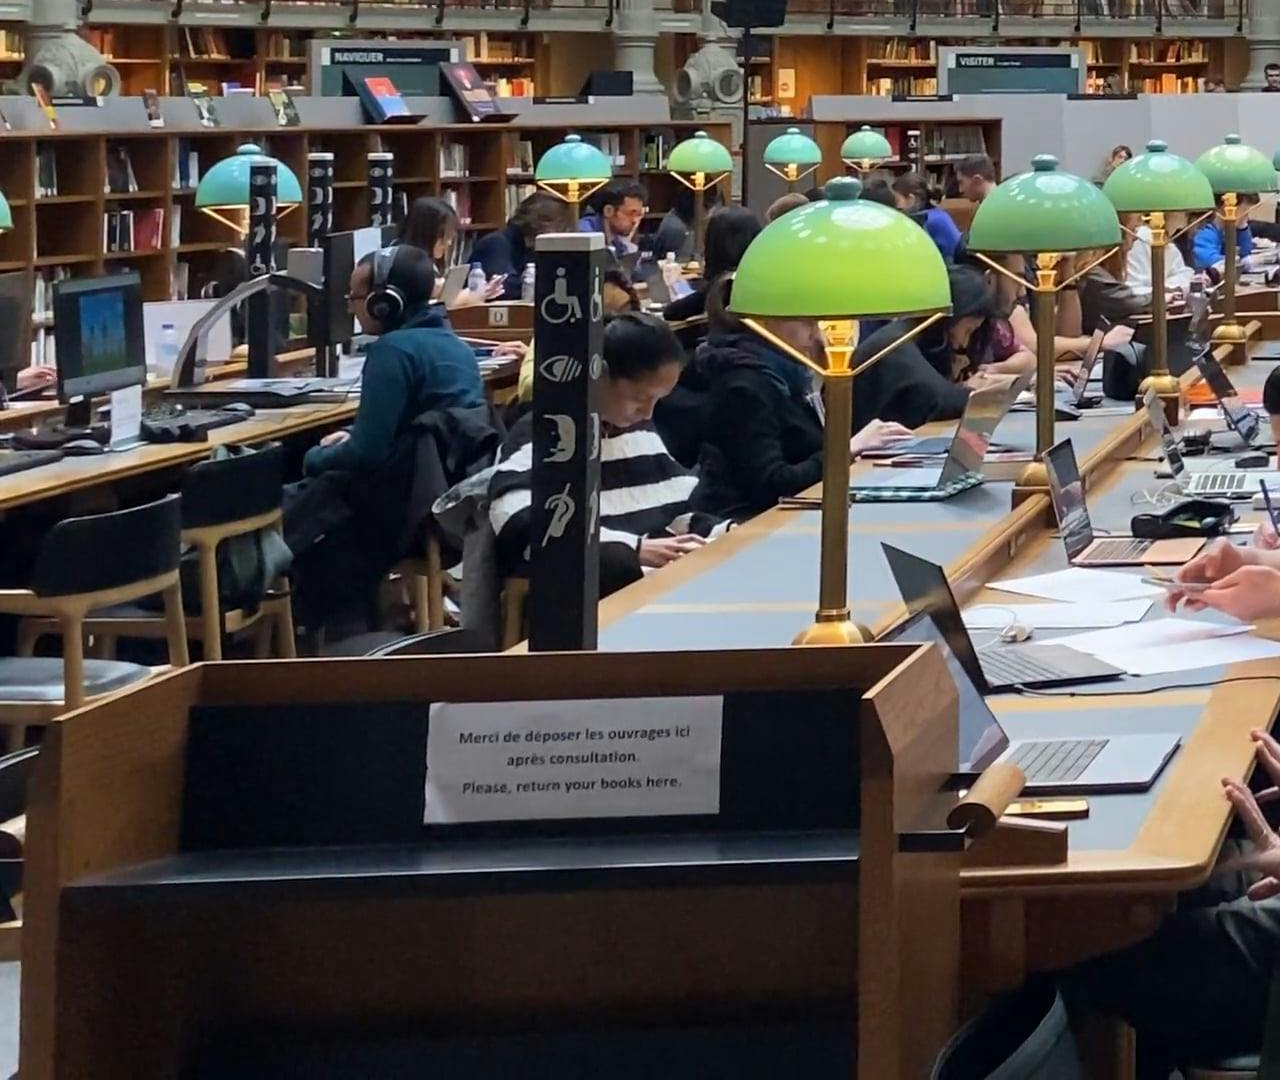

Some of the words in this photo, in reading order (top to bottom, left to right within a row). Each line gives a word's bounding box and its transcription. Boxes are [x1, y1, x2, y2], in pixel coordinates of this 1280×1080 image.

[334, 52, 384, 62] NAVIGUER
[959, 57, 995, 66] VISITER
[459, 731, 499, 744] Merci
[503, 730, 521, 743] de
[525, 729, 581, 745] déposer
[585, 728, 604, 740] les
[608, 728, 671, 741] ouvrages
[675, 725, 690, 738] ici
[506, 752, 545, 768] après
[550, 751, 640, 765] consultation.
[462, 780, 512, 795] Please,
[516, 780, 560, 793] return
[565, 779, 597, 792] your
[601, 776, 642, 789] books
[647, 774, 681, 788] here.
